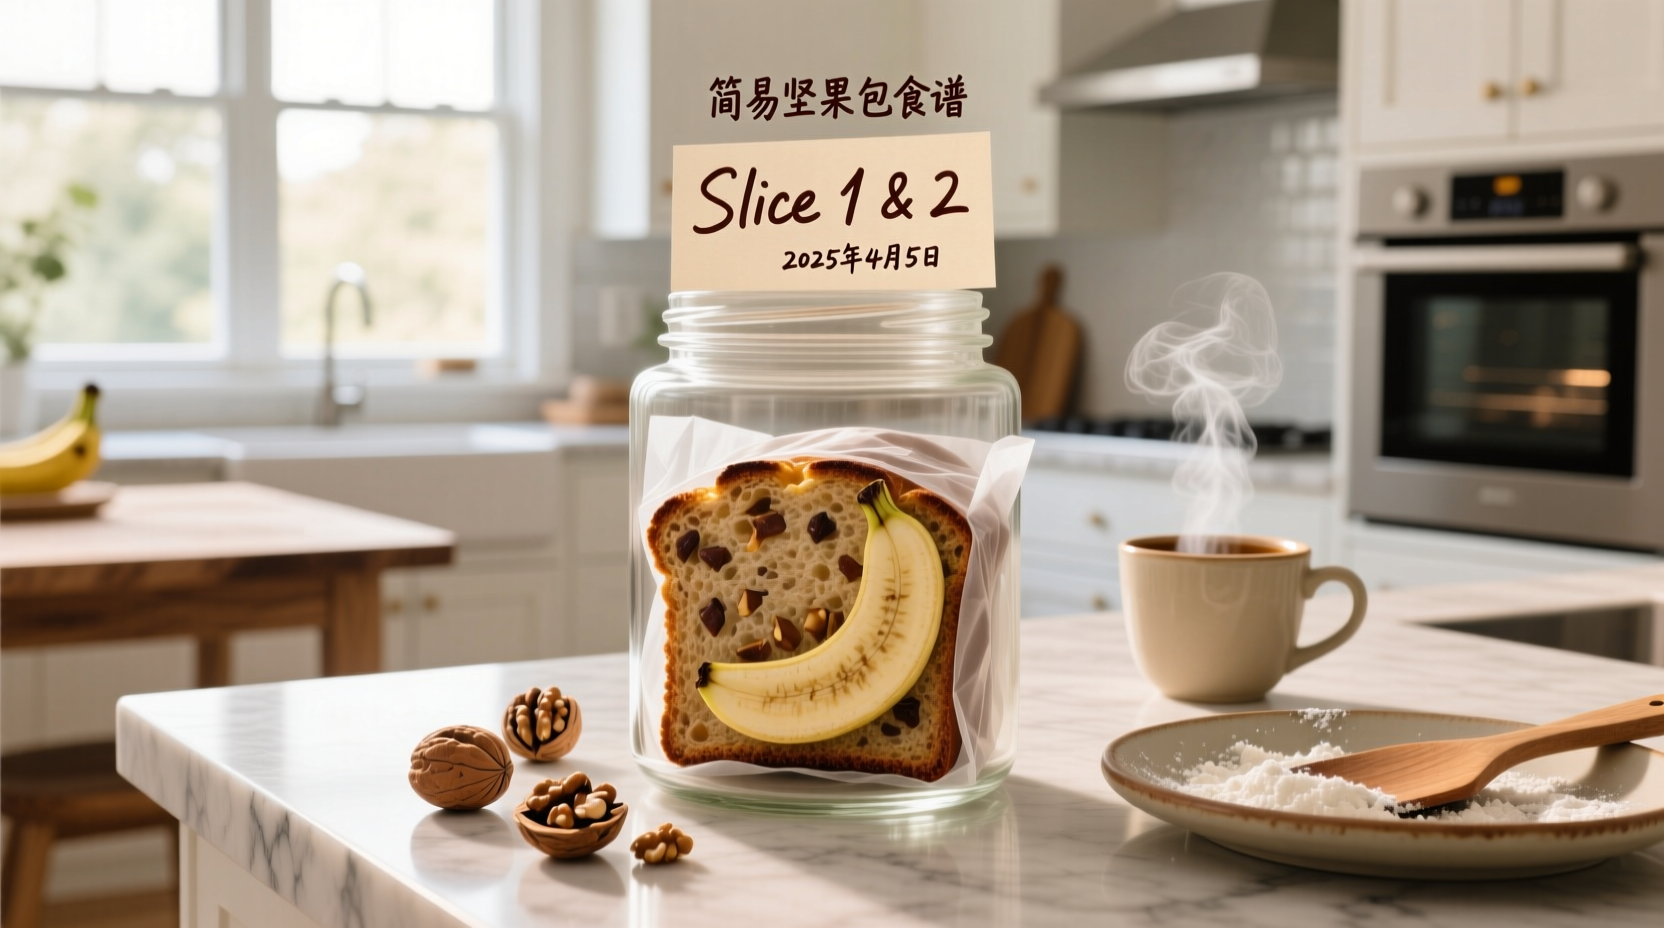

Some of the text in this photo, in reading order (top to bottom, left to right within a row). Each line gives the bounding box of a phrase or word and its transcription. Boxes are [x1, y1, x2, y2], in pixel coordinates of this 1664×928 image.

[693, 167, 969, 234] Slice 1 & 2
[782, 243, 938, 274] 2025年4月5日
